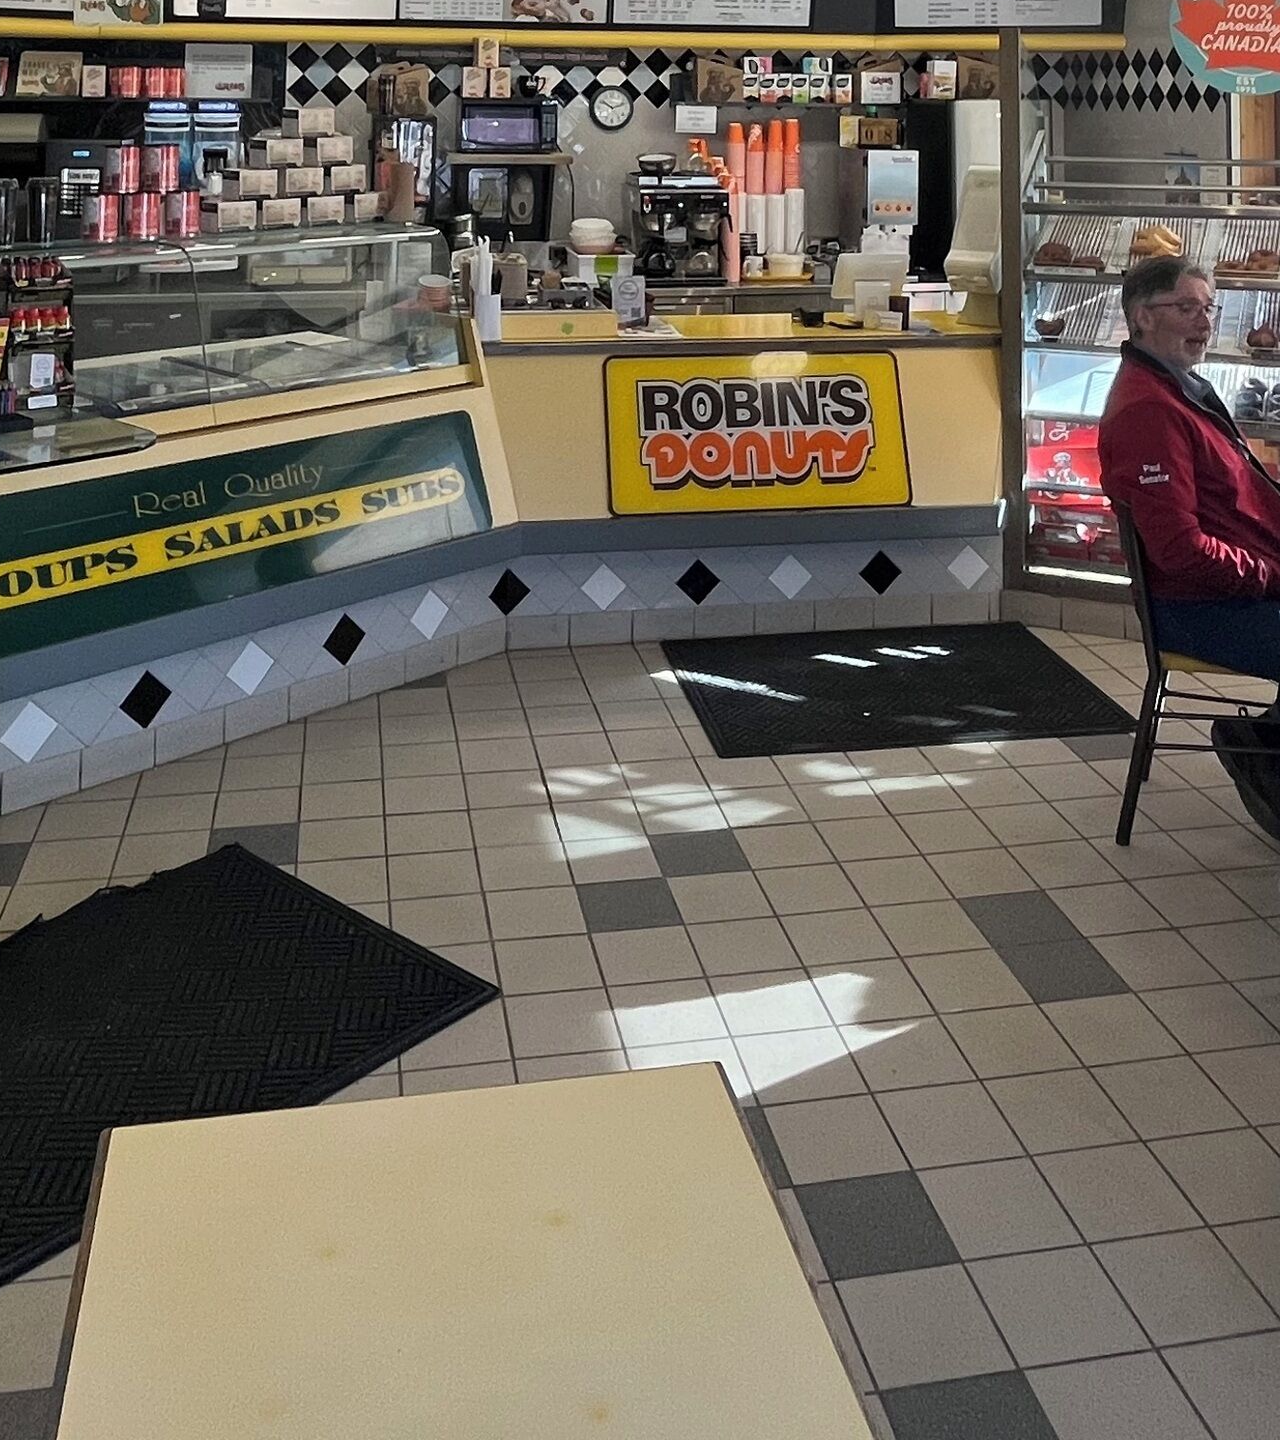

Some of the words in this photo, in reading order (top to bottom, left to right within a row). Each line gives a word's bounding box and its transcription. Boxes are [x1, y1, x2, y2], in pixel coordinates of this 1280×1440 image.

[1226, 3, 1274, 20] 100%
[1235, 77, 1256, 85] EST
[640, 378, 868, 431] ROBIN'S
[644, 428, 871, 479] DONUTS
[134, 480, 206, 519] Real
[224, 463, 323, 499] Quality
[164, 499, 341, 560] SALADS
[361, 468, 463, 515] SUBS
